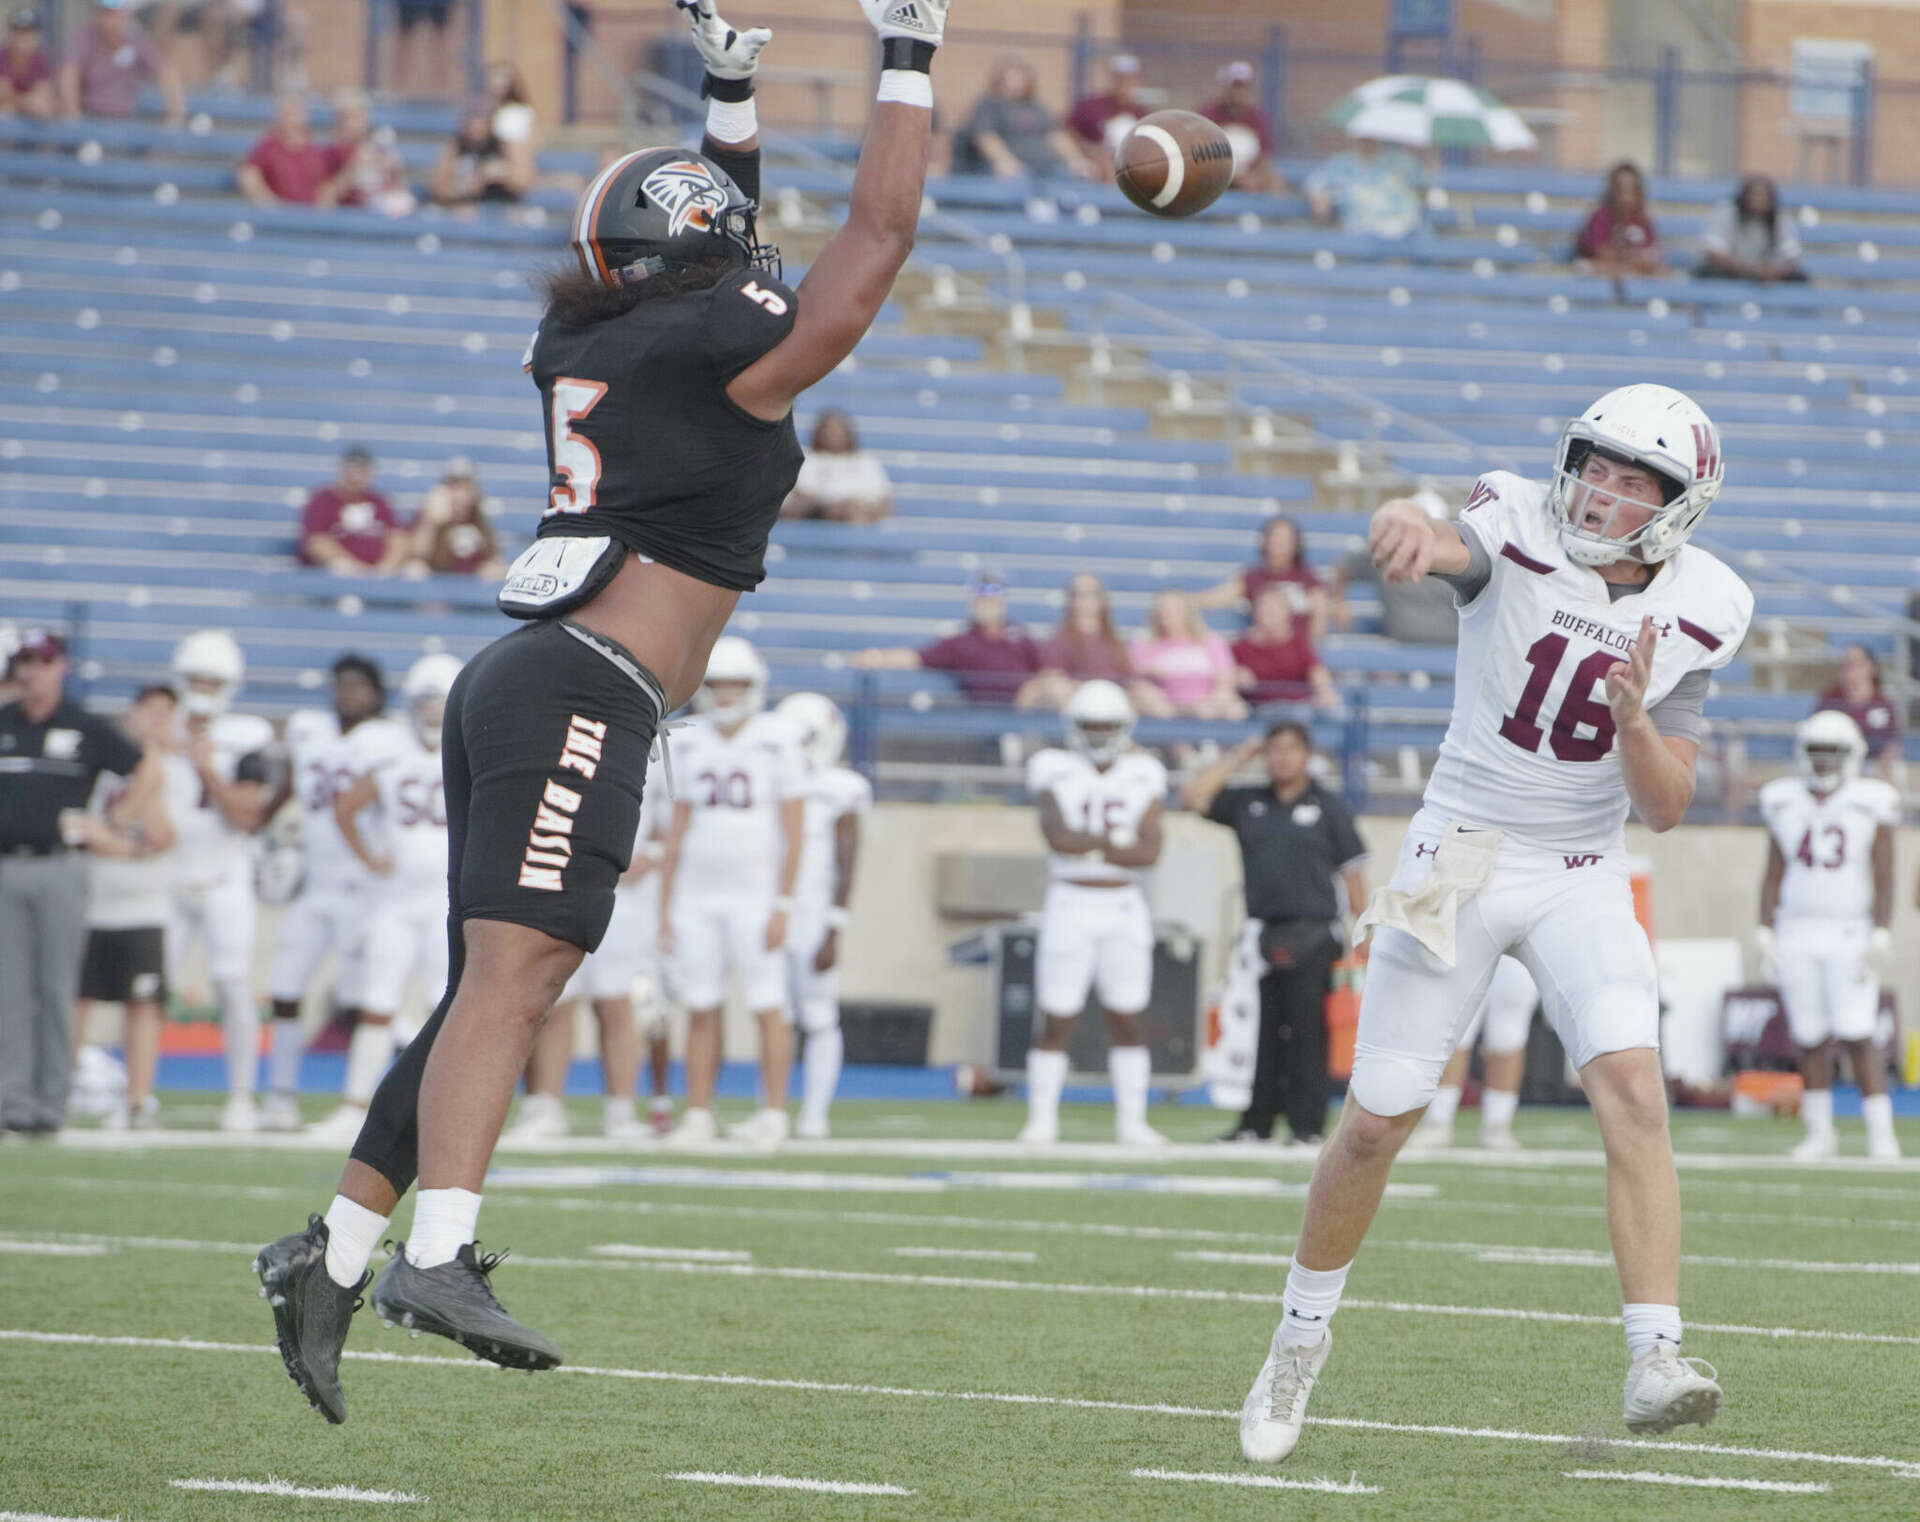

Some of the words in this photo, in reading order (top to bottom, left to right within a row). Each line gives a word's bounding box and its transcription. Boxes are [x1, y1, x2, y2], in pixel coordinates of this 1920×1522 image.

[741, 280, 788, 316] 5
[550, 376, 609, 516] 5
[1498, 632, 1632, 762] 16
[558, 713, 607, 781] THE
[517, 777, 582, 892] BASIN
[1562, 853, 1604, 870] WT
[1797, 822, 1848, 870] 43
